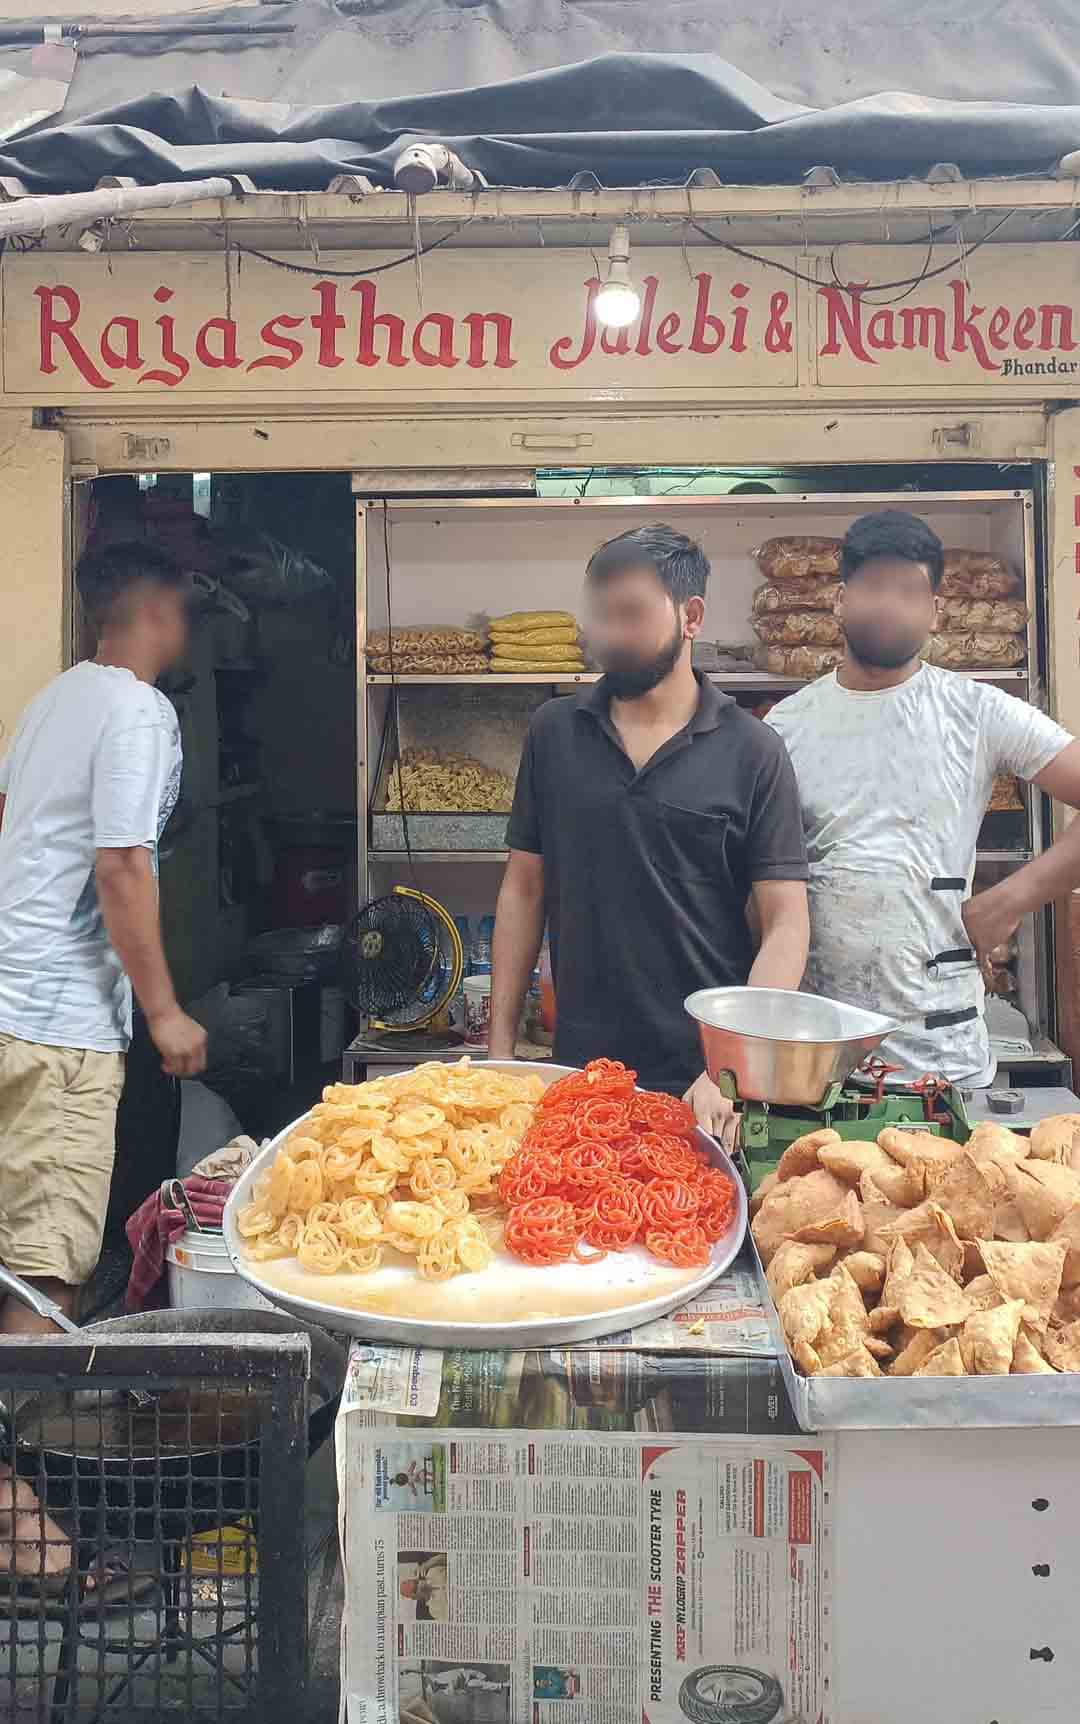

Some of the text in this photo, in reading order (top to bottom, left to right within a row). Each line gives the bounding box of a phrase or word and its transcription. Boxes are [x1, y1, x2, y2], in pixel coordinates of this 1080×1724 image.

[33, 271, 1079, 389] Rajasthan Jalebi & Namkeen
[1000, 356, 1078, 376] Bhandar
[374, 1539, 385, 1552] 75
[675, 1488, 687, 1575] ZAPPER
[375, 1552, 385, 1576] turns
[648, 1489, 662, 1702] PRESENTING THE SCOOTER TYRE
[375, 1599, 388, 1634] utopian
[375, 1642, 386, 1652] to
[375, 1654, 386, 1703] throwback
